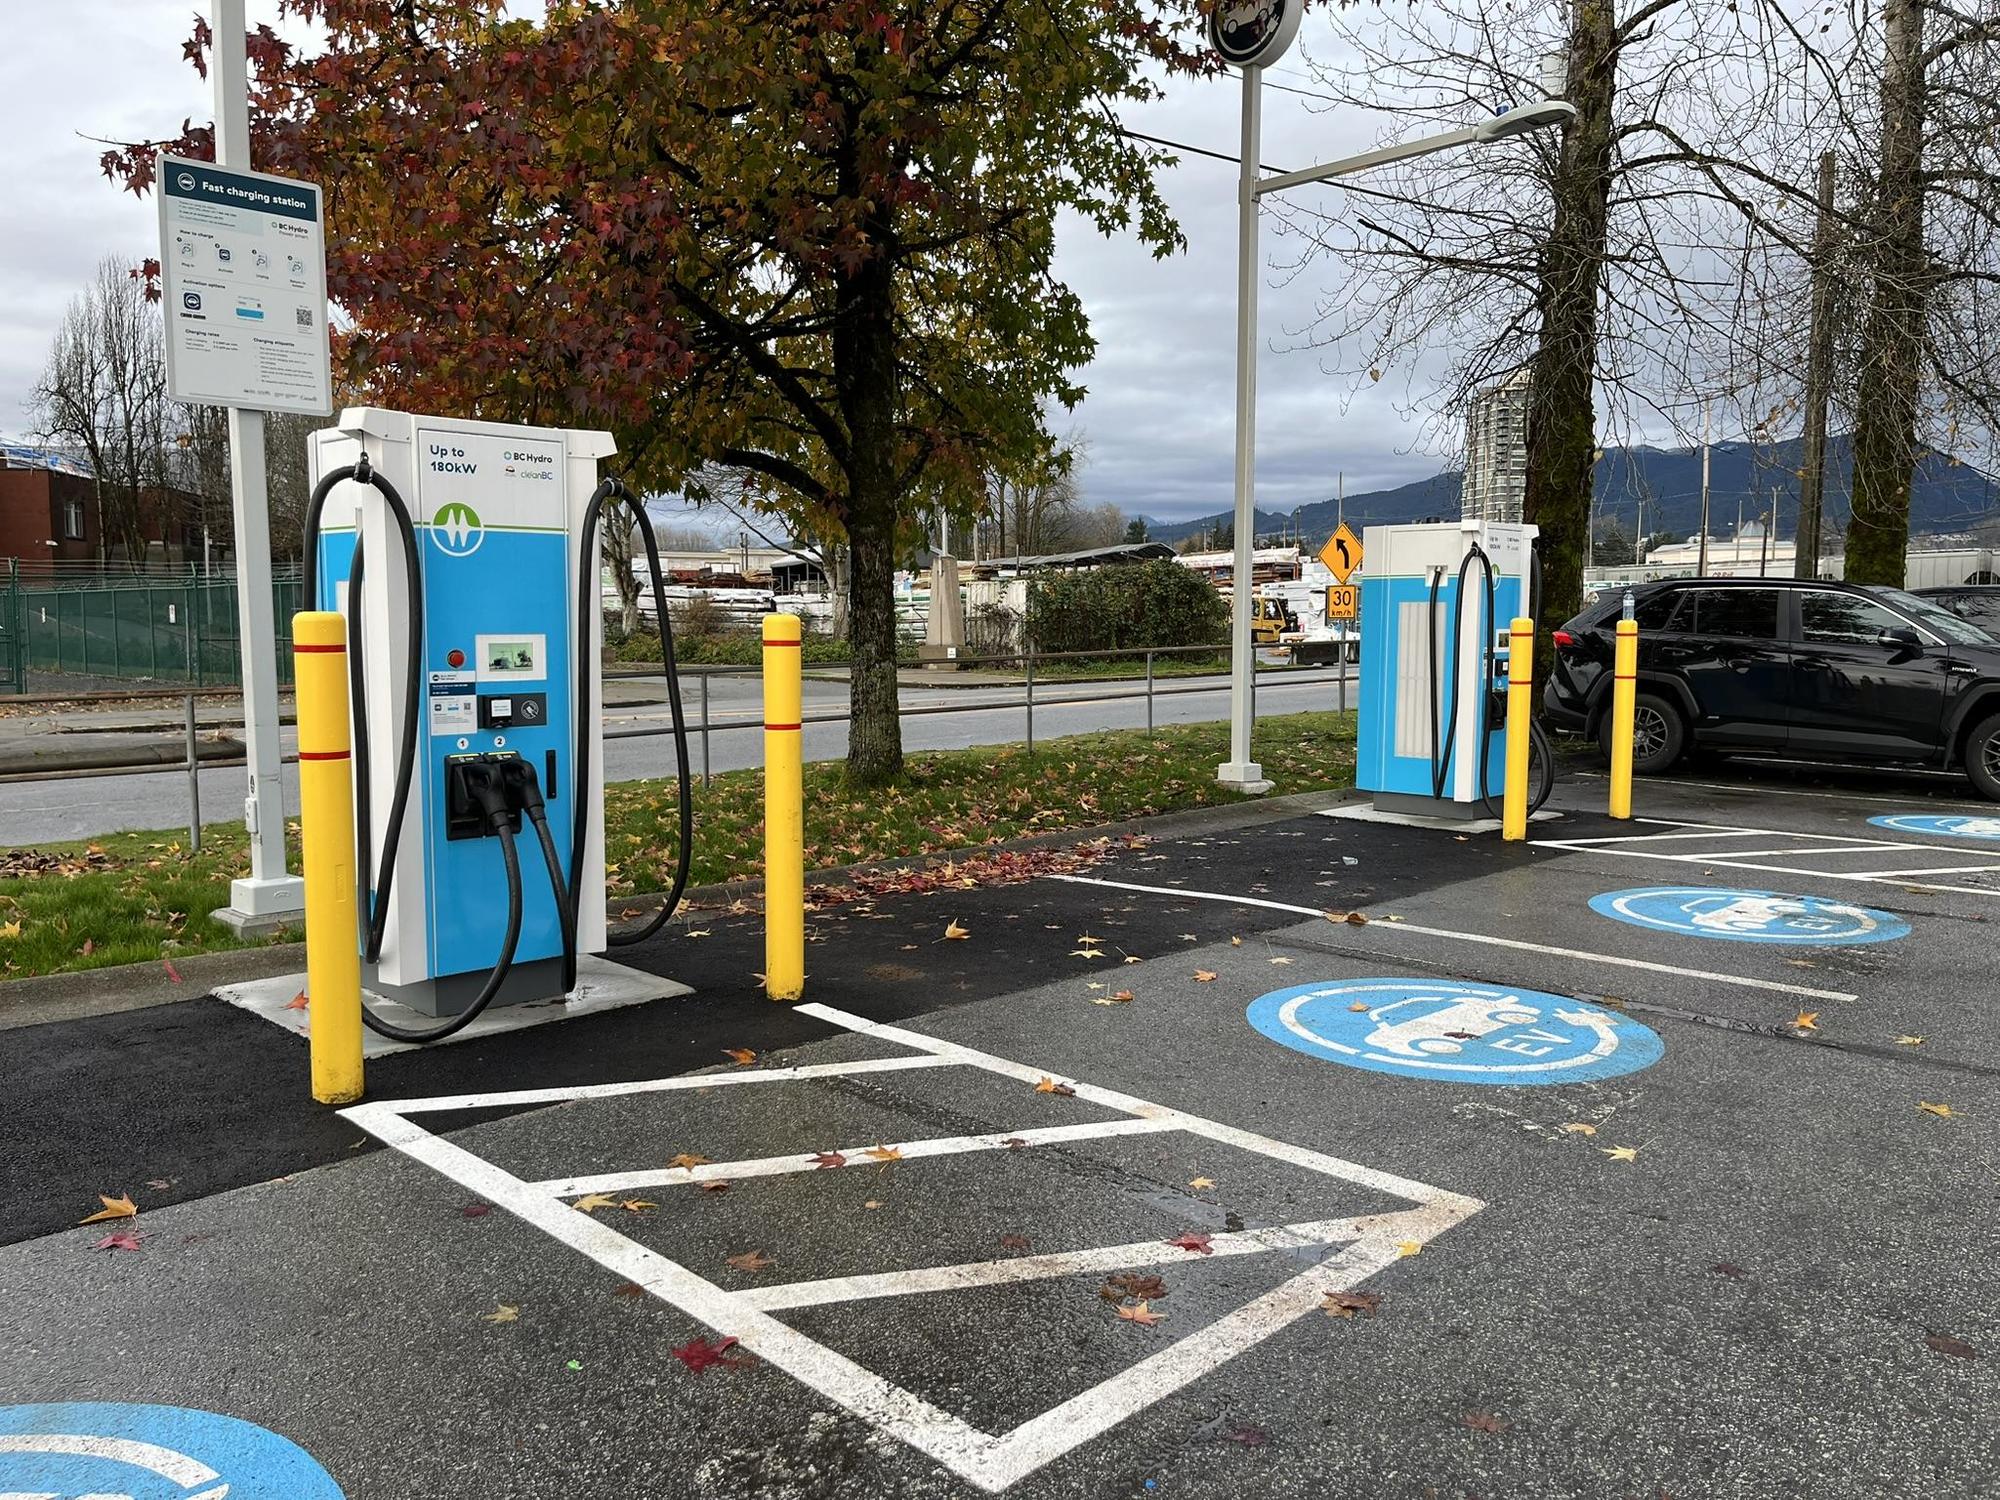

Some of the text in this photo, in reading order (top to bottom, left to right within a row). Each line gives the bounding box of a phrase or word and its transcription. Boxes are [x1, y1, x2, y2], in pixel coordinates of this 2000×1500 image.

[203, 181, 307, 209] Fast charging station
[288, 225, 309, 234] Hydro
[183, 279, 207, 287] Activation
[253, 337, 274, 345] Charging
[430, 444, 465, 459] Up to
[513, 452, 553, 464] BC Hydro
[430, 461, 477, 474] 180kW
[520, 470, 553, 480] cleanBC
[1334, 591, 1351, 606] 30
[1490, 1028, 1572, 1057] EV
